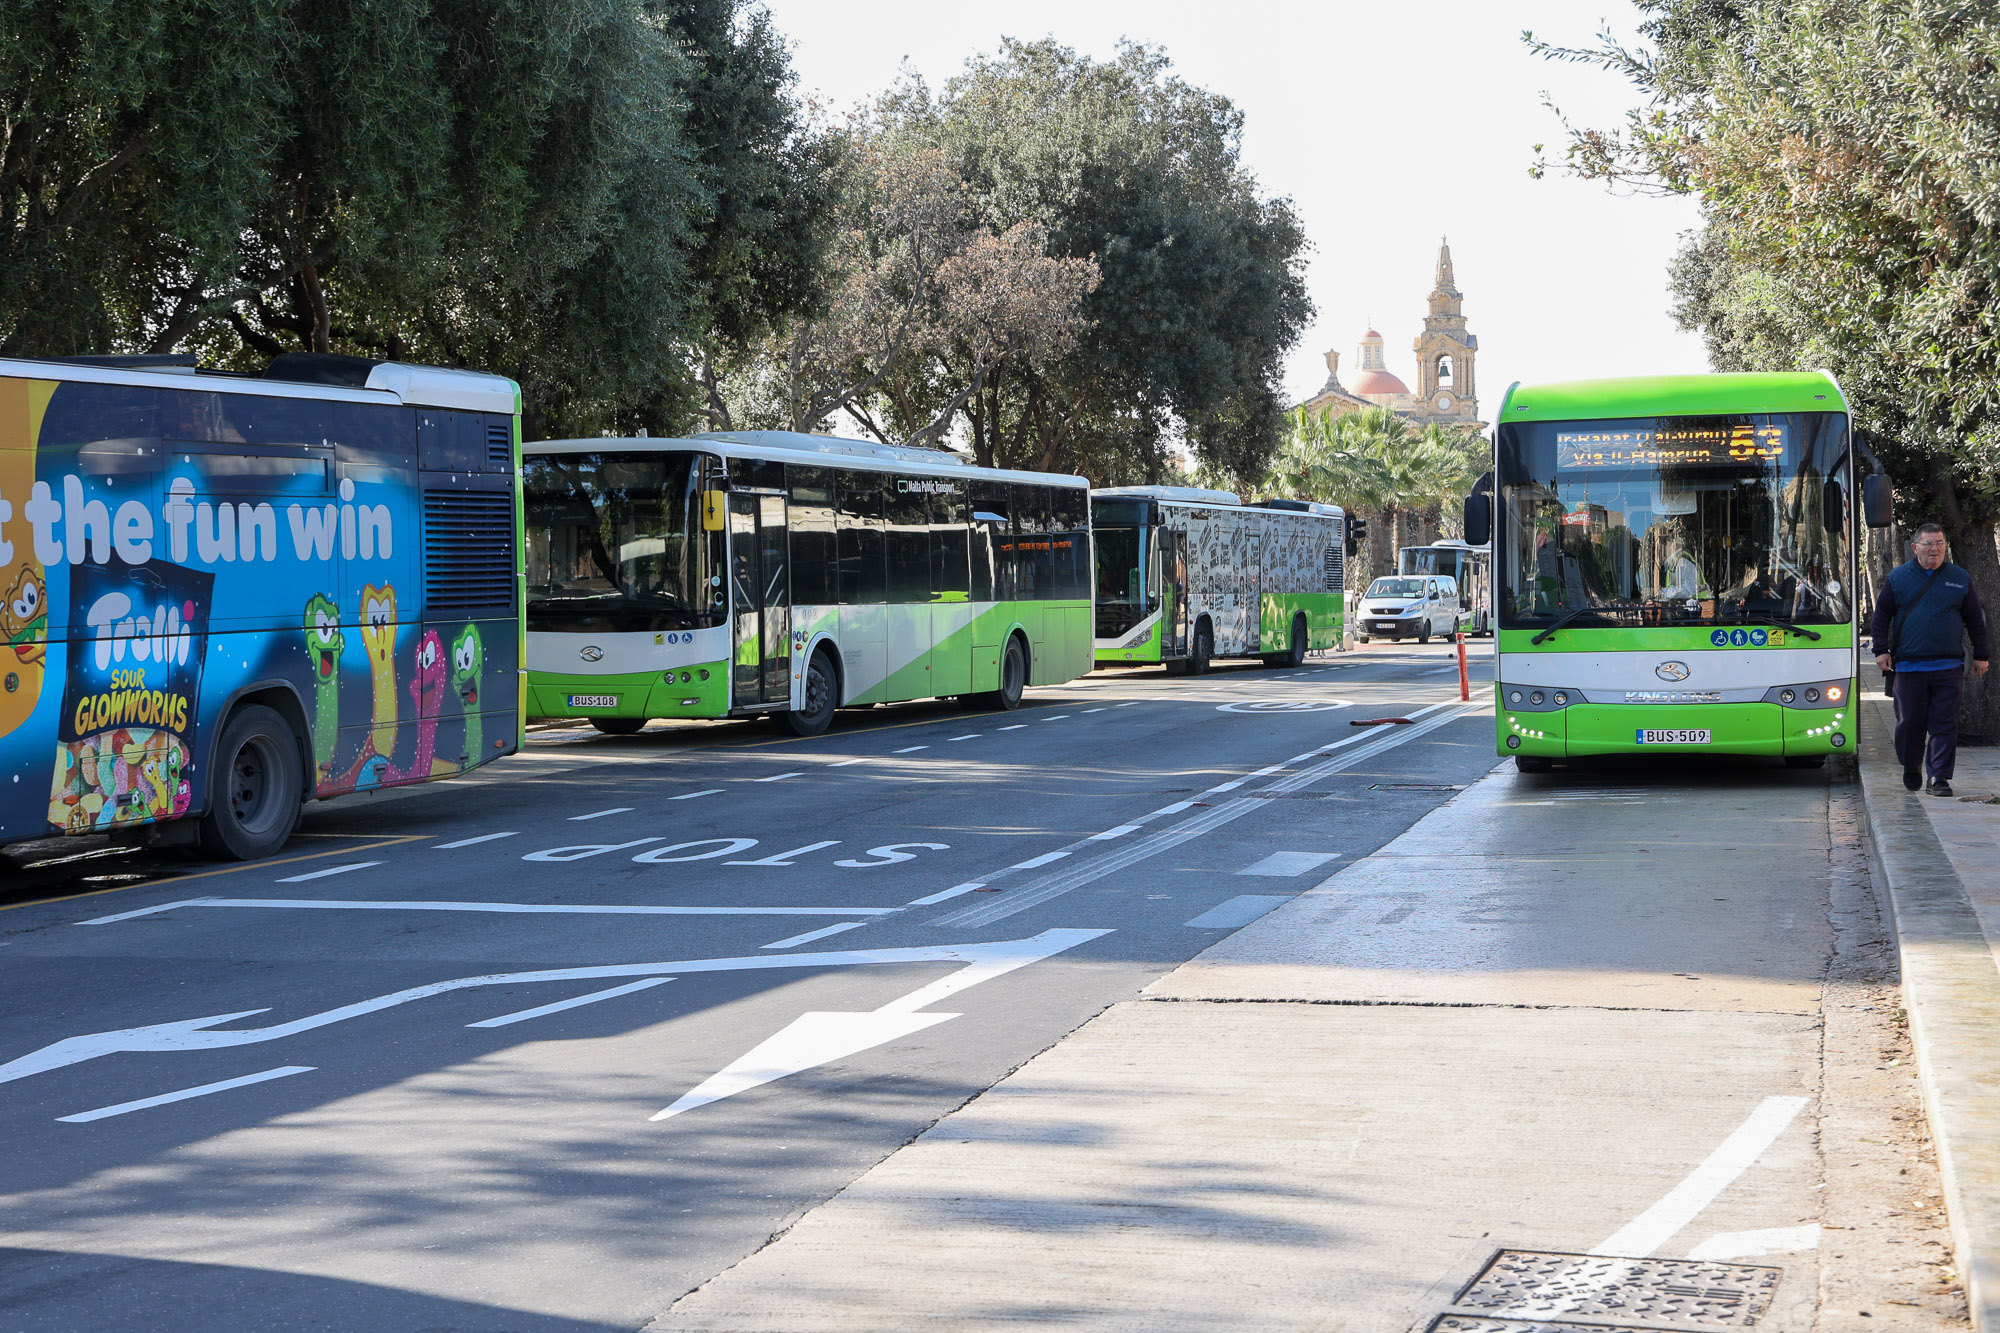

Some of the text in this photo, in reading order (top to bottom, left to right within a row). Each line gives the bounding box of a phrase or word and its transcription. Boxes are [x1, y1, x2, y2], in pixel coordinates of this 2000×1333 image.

[1573, 452, 1604, 465] Via
[1729, 425, 1783, 461] 53
[909, 480, 955, 495] Malta Public Transport
[24, 474, 154, 567] the
[163, 477, 276, 564] fun
[287, 478, 393, 561] win
[87, 592, 195, 671] Trolli
[110, 668, 146, 690] SOUR
[74, 689, 188, 736] GLOWWORMS
[521, 837, 951, 868] STOP
